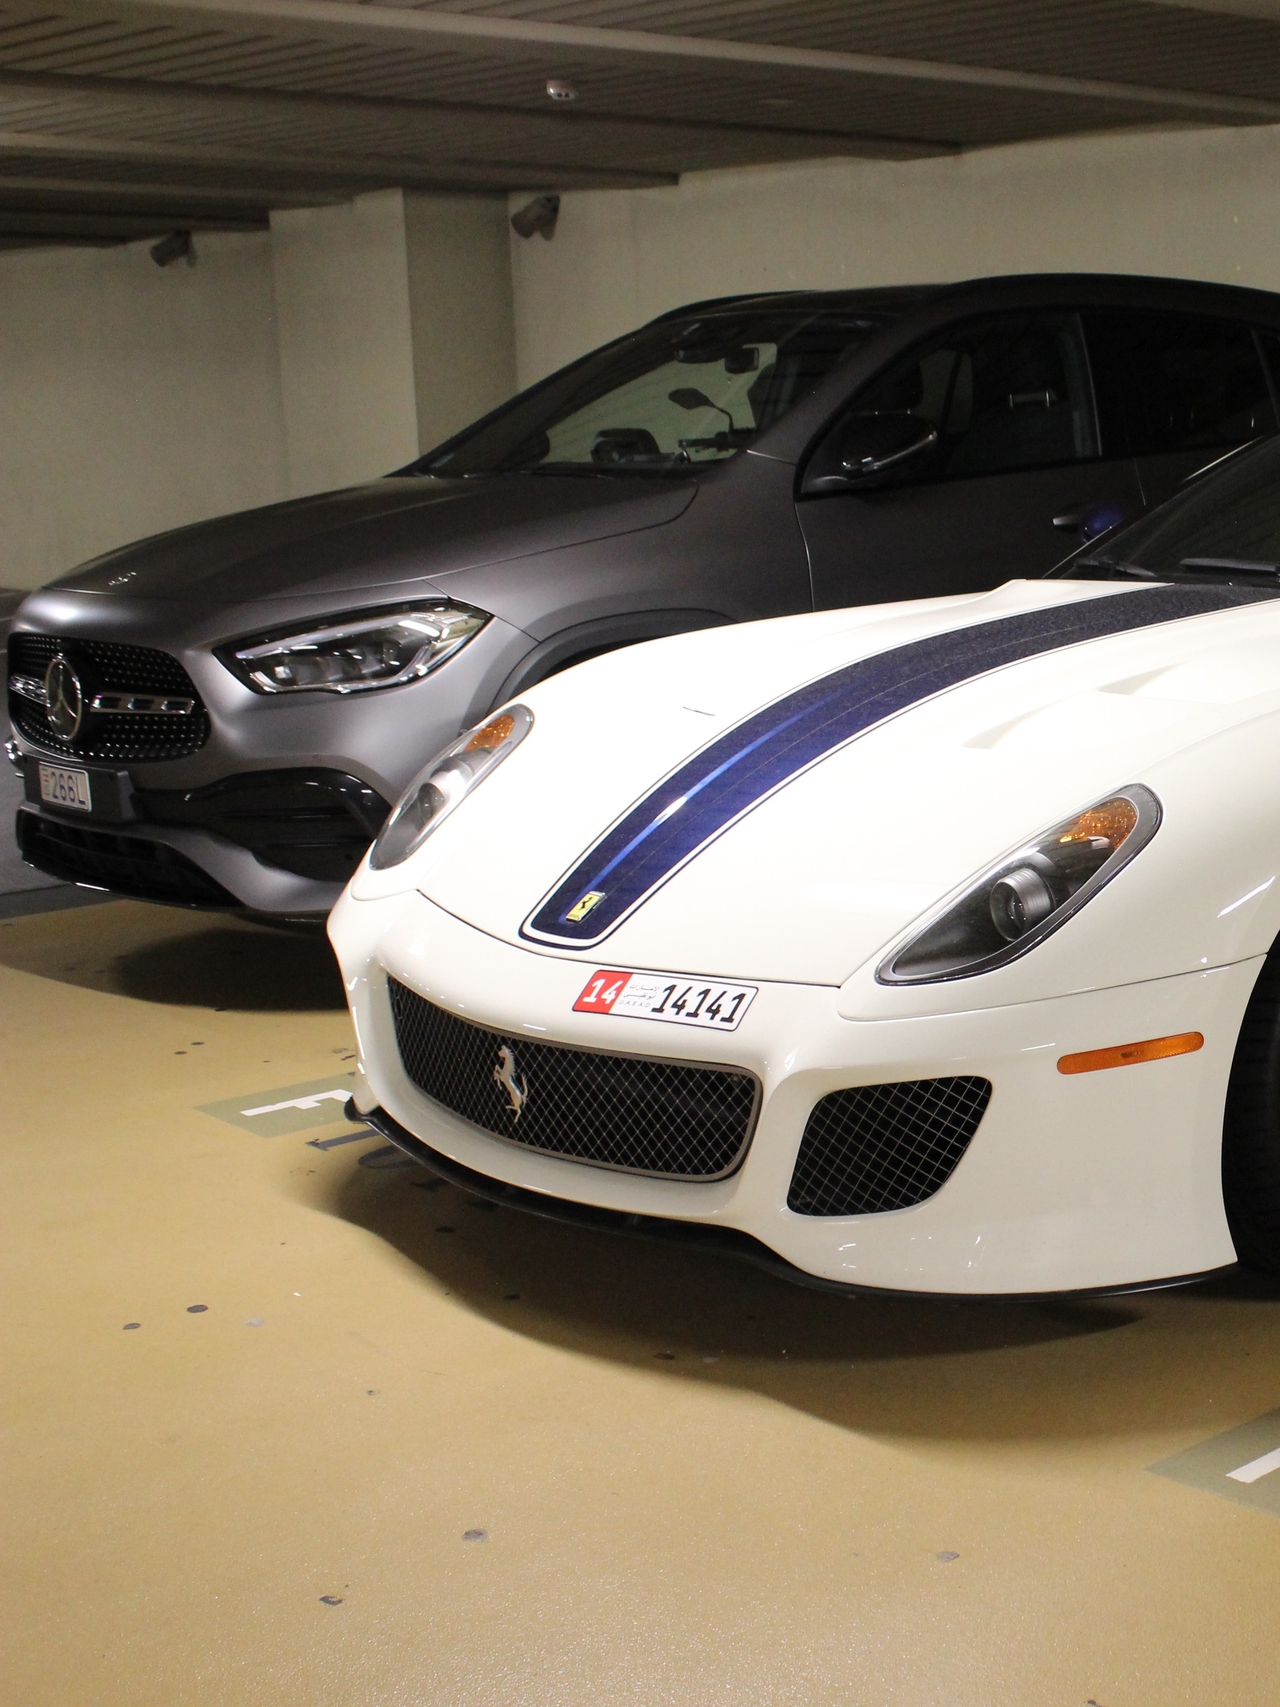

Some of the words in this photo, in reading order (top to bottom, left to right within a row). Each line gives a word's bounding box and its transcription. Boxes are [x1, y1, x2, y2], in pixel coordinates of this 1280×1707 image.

[51, 771, 86, 806] 266L
[583, 979, 624, 1004] 14
[651, 984, 747, 1023] 14141
